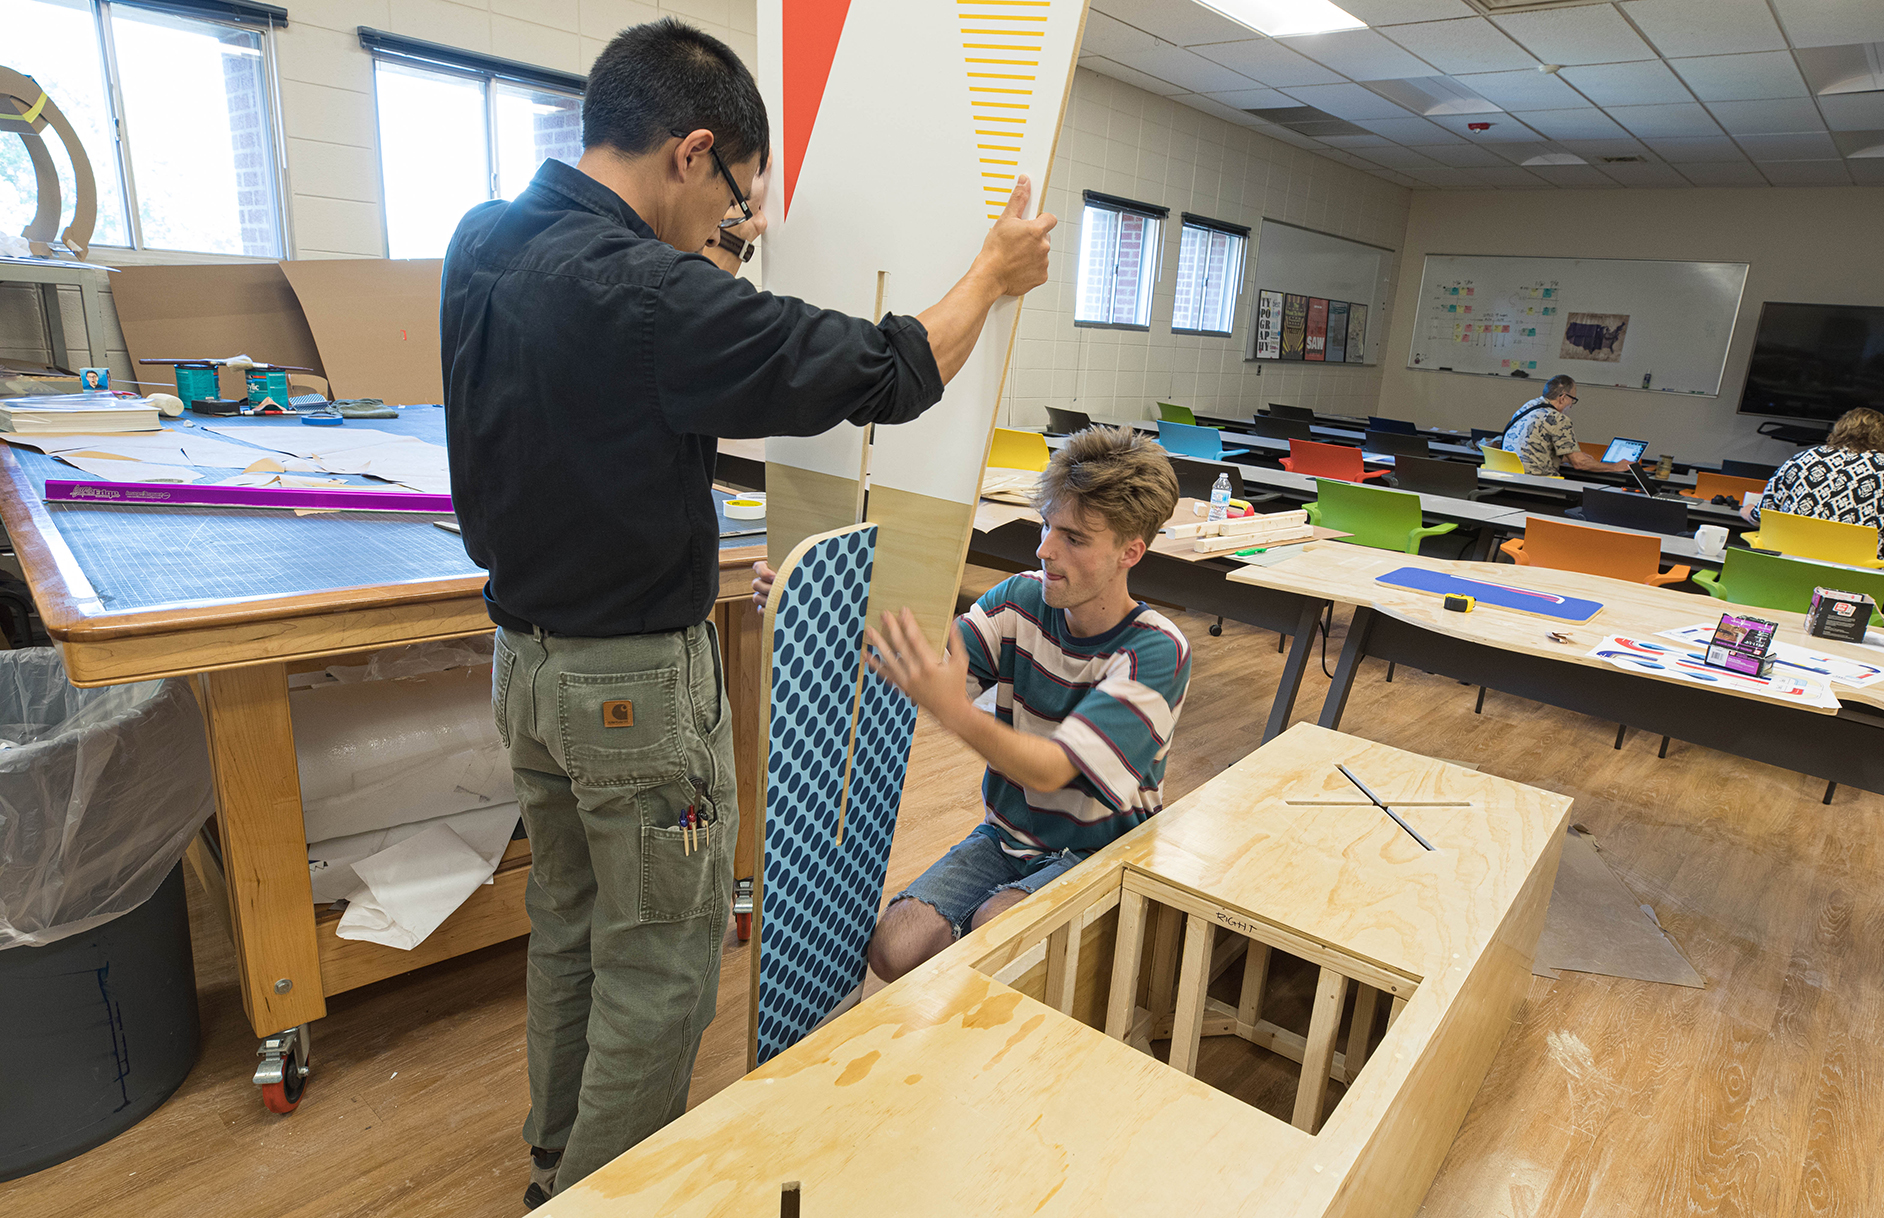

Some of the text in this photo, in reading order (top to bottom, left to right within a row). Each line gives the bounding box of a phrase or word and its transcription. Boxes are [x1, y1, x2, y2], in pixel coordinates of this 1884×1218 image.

[1261, 309, 1270, 318] PO
[1260, 320, 1270, 330] GR
[1307, 336, 1325, 350] SAW
[1216, 912, 1257, 932] RIGHT
